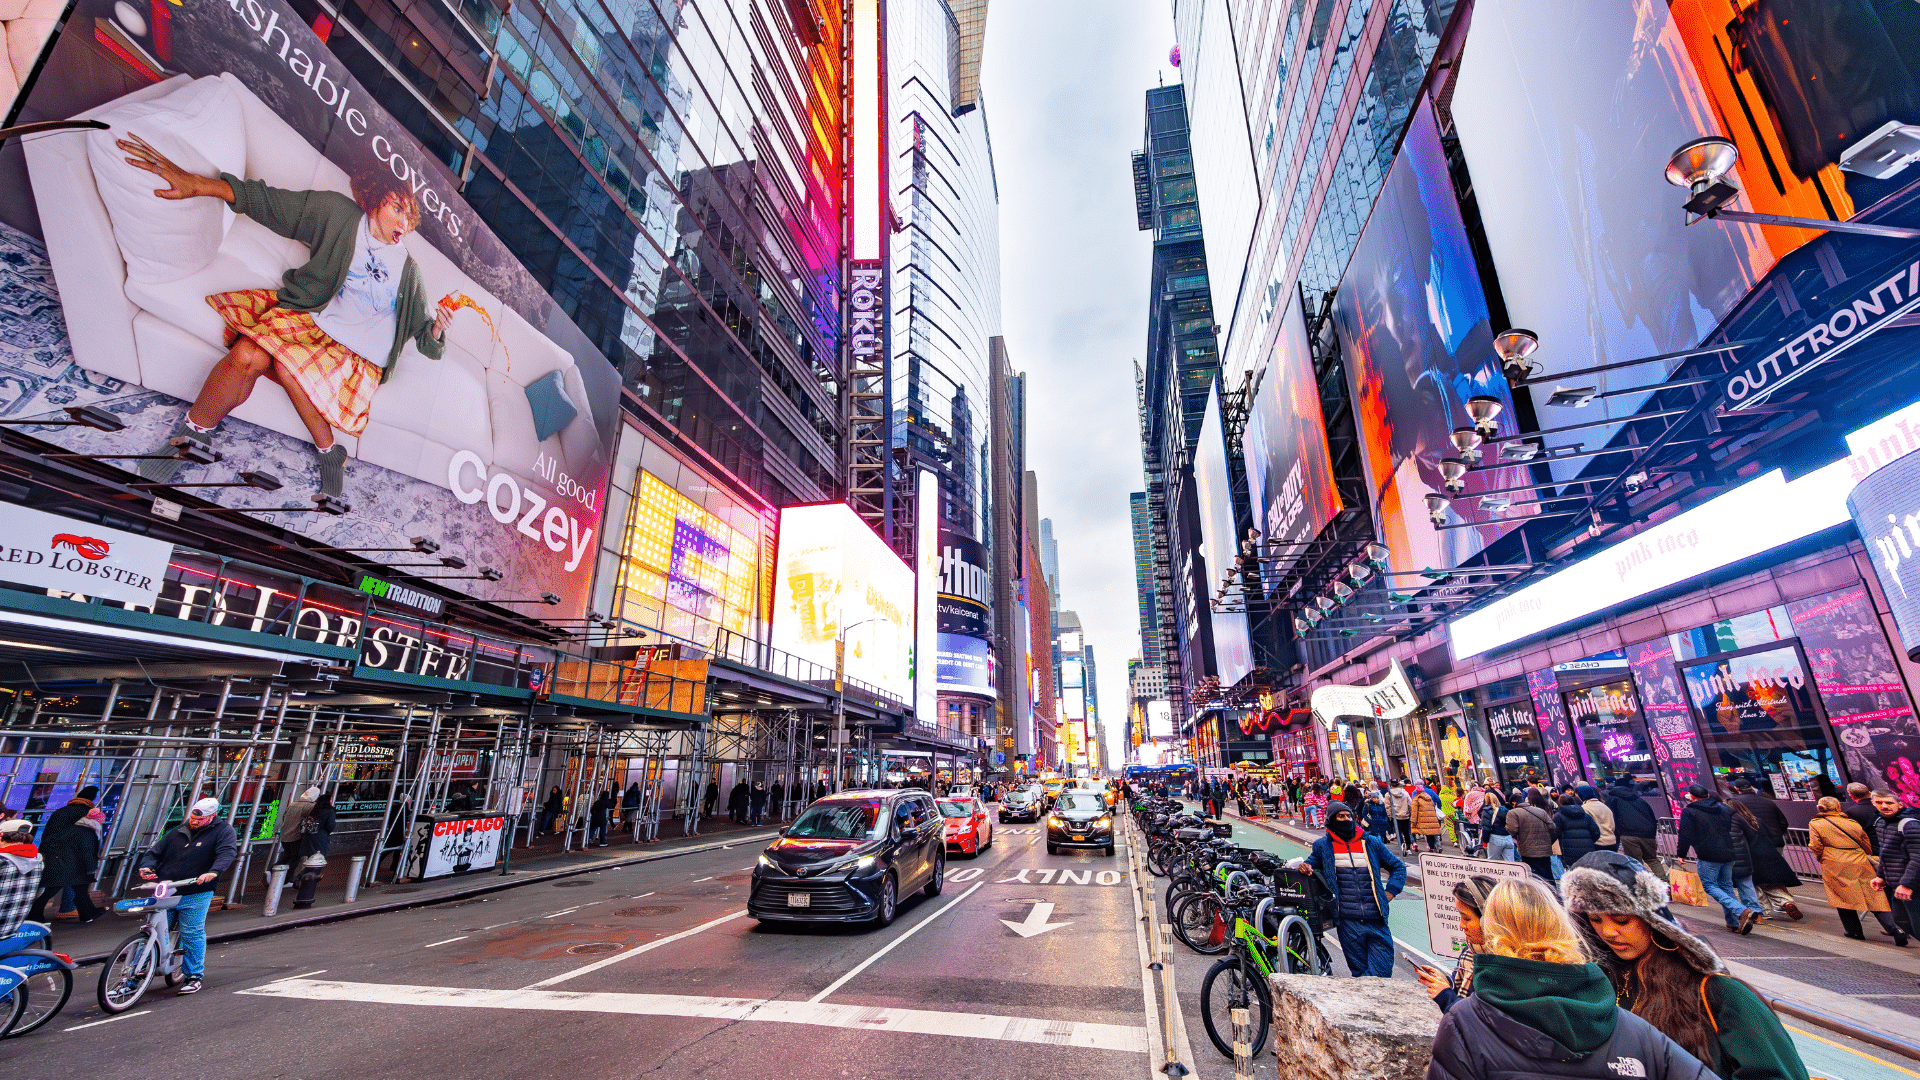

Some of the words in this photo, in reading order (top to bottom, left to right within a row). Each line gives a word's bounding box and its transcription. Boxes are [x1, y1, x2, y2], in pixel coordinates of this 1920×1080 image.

[228, 0, 367, 137] shable
[371, 135, 464, 243] covers.
[852, 268, 880, 356] ROKU
[531, 451, 557, 484] All
[558, 471, 597, 513] good.
[0, 544, 44, 565] ED
[48, 551, 152, 591] LOBSTER
[1615, 540, 1653, 583] pink
[1656, 527, 1699, 555] taco
[1568, 691, 1600, 729] pink
[1603, 691, 1637, 713] taco
[1689, 664, 1741, 719] pink
[1745, 663, 1805, 691] taco
[1489, 708, 1511, 742] pink
[358, 744, 395, 756] LOBSTER
[433, 816, 504, 836] CHICAGO
[1433, 861, 1463, 870] LONG-TERM
[1465, 864, 1477, 872] BIKE
[1607, 1061, 1635, 1073] NORTH
